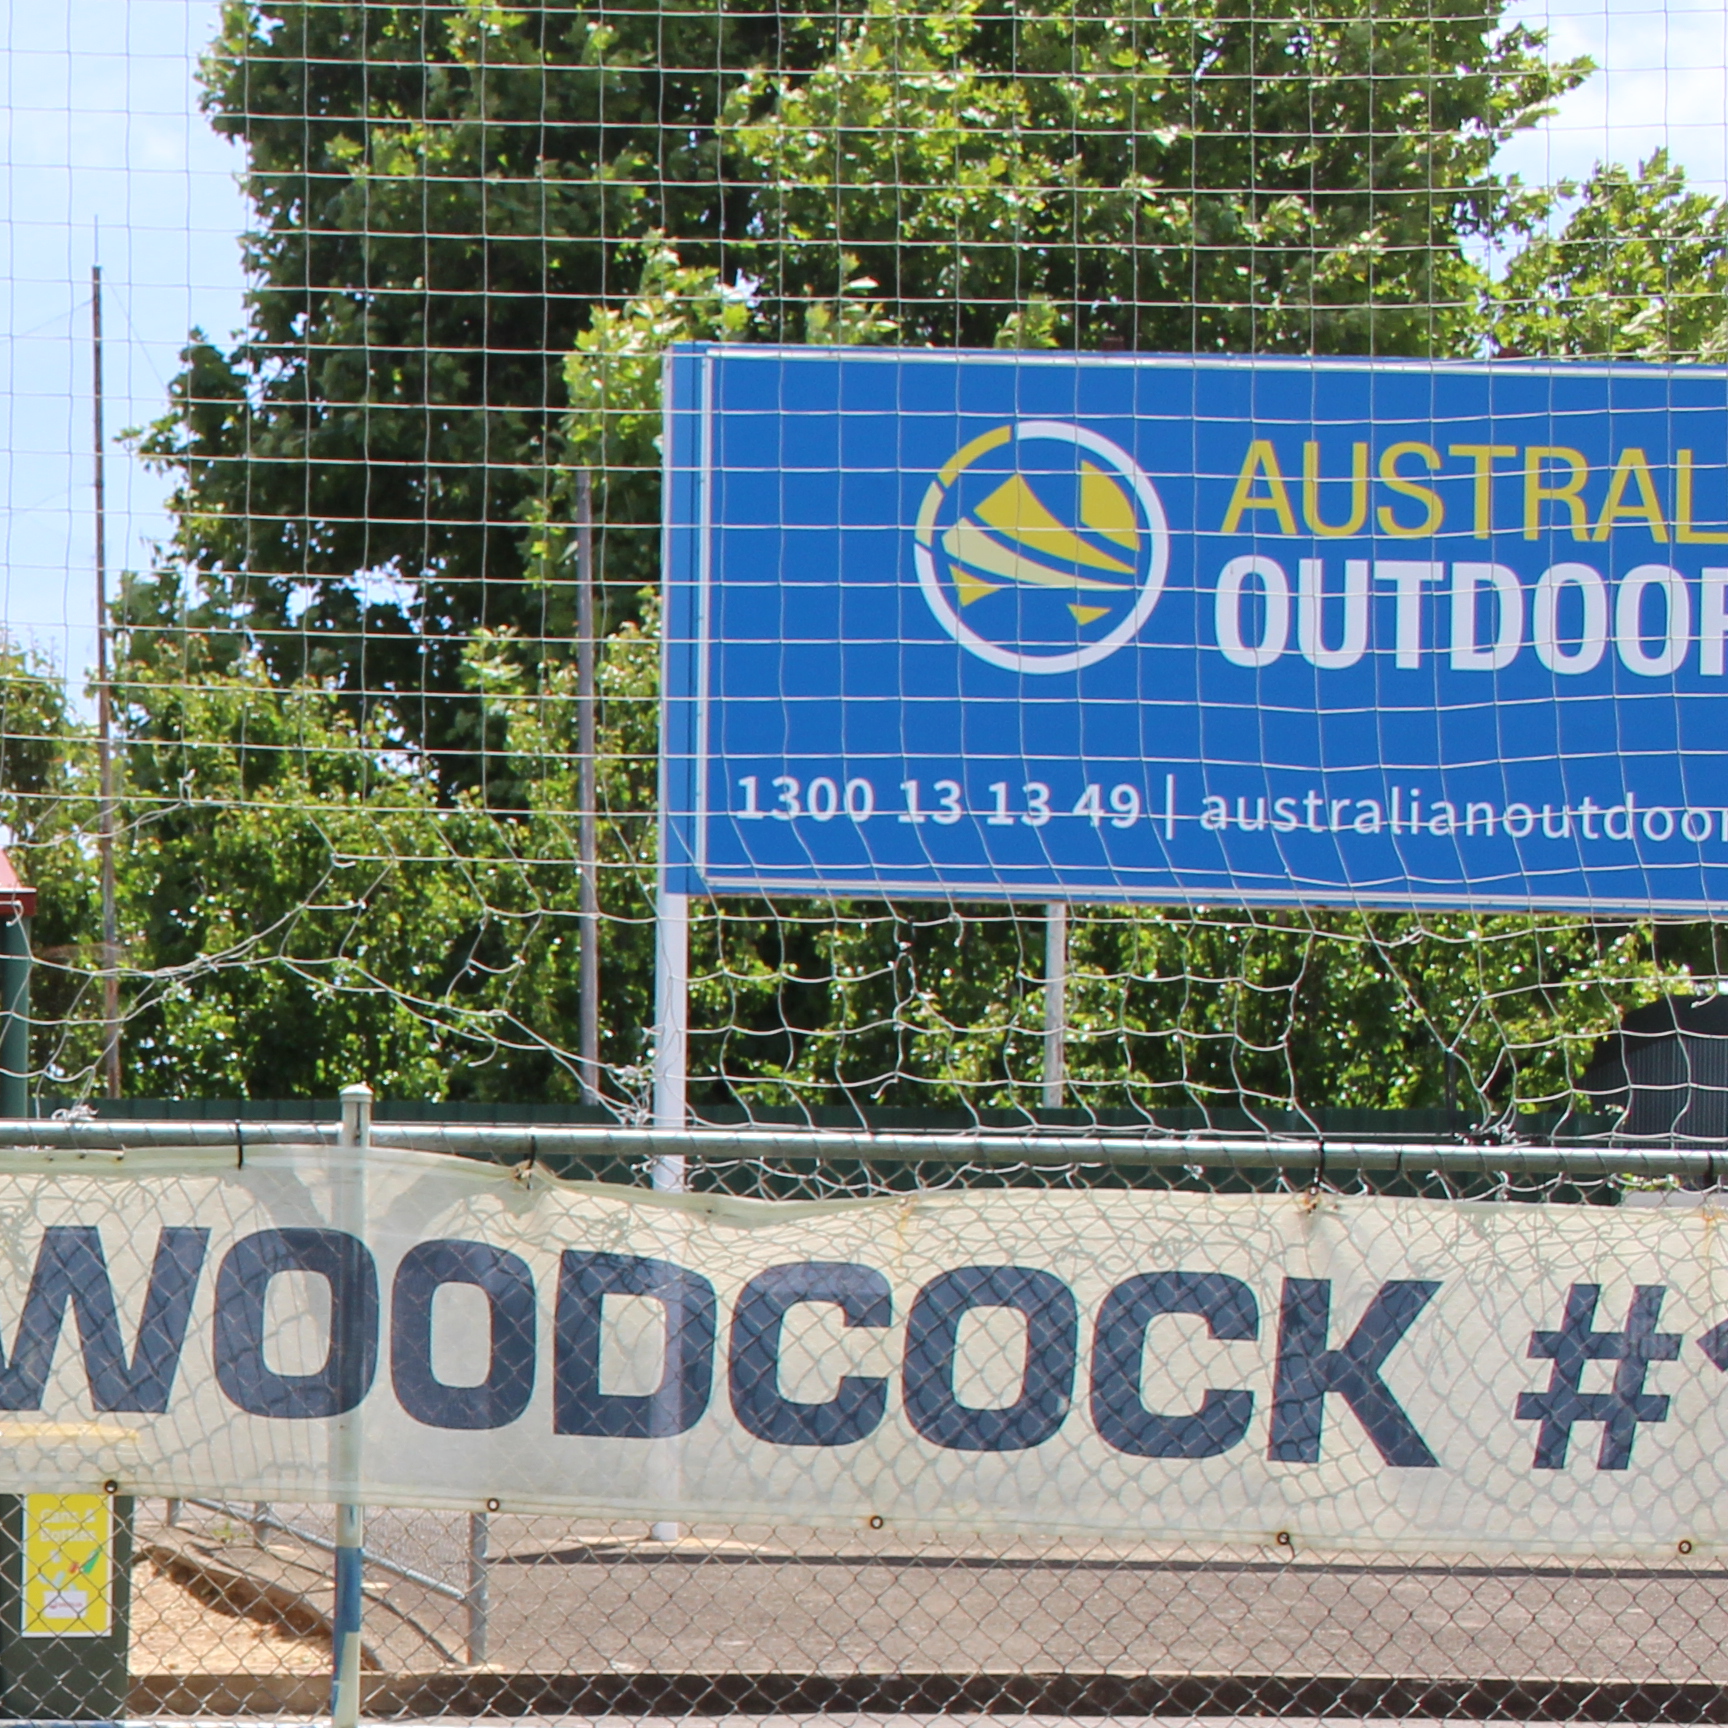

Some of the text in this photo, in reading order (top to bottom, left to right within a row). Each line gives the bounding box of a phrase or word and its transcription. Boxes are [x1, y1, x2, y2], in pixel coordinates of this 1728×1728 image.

[1222, 440, 1728, 545] AUSTRAL
[737, 776, 875, 824] 1300
[897, 779, 963, 827] 13
[986, 781, 1053, 829] 13
[1073, 783, 1142, 831] 49
[1198, 785, 1728, 844] australianoutdoo
